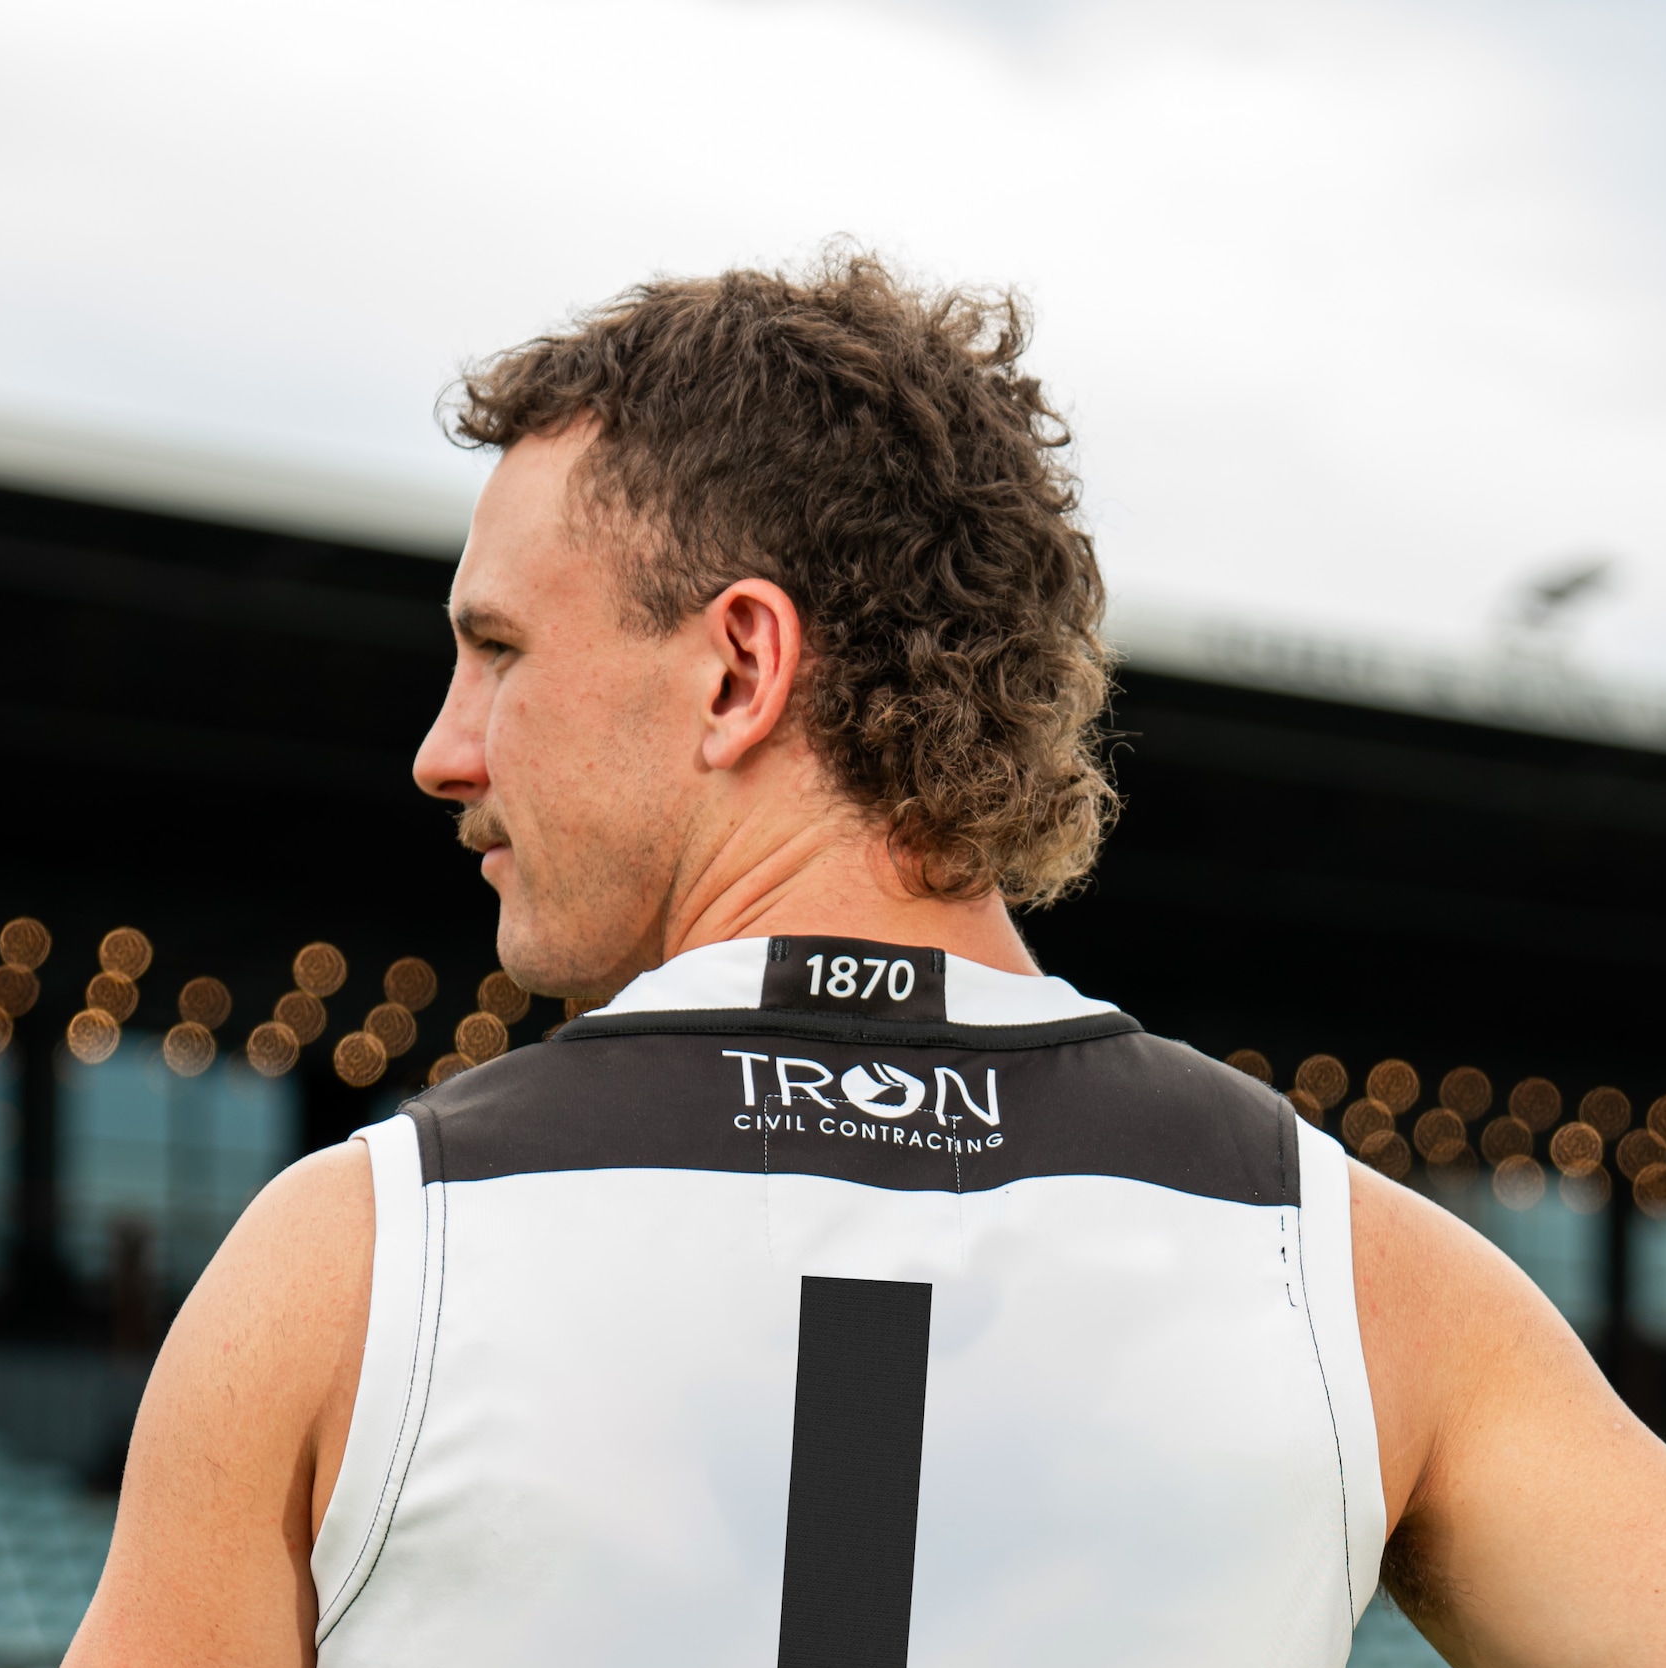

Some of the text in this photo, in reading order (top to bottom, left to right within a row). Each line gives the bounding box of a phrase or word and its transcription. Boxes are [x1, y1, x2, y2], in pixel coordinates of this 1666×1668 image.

[805, 953, 916, 1002] 1870
[721, 1049, 1002, 1127] TRON
[733, 1113, 1004, 1154] CIVIL CONTRACTING
